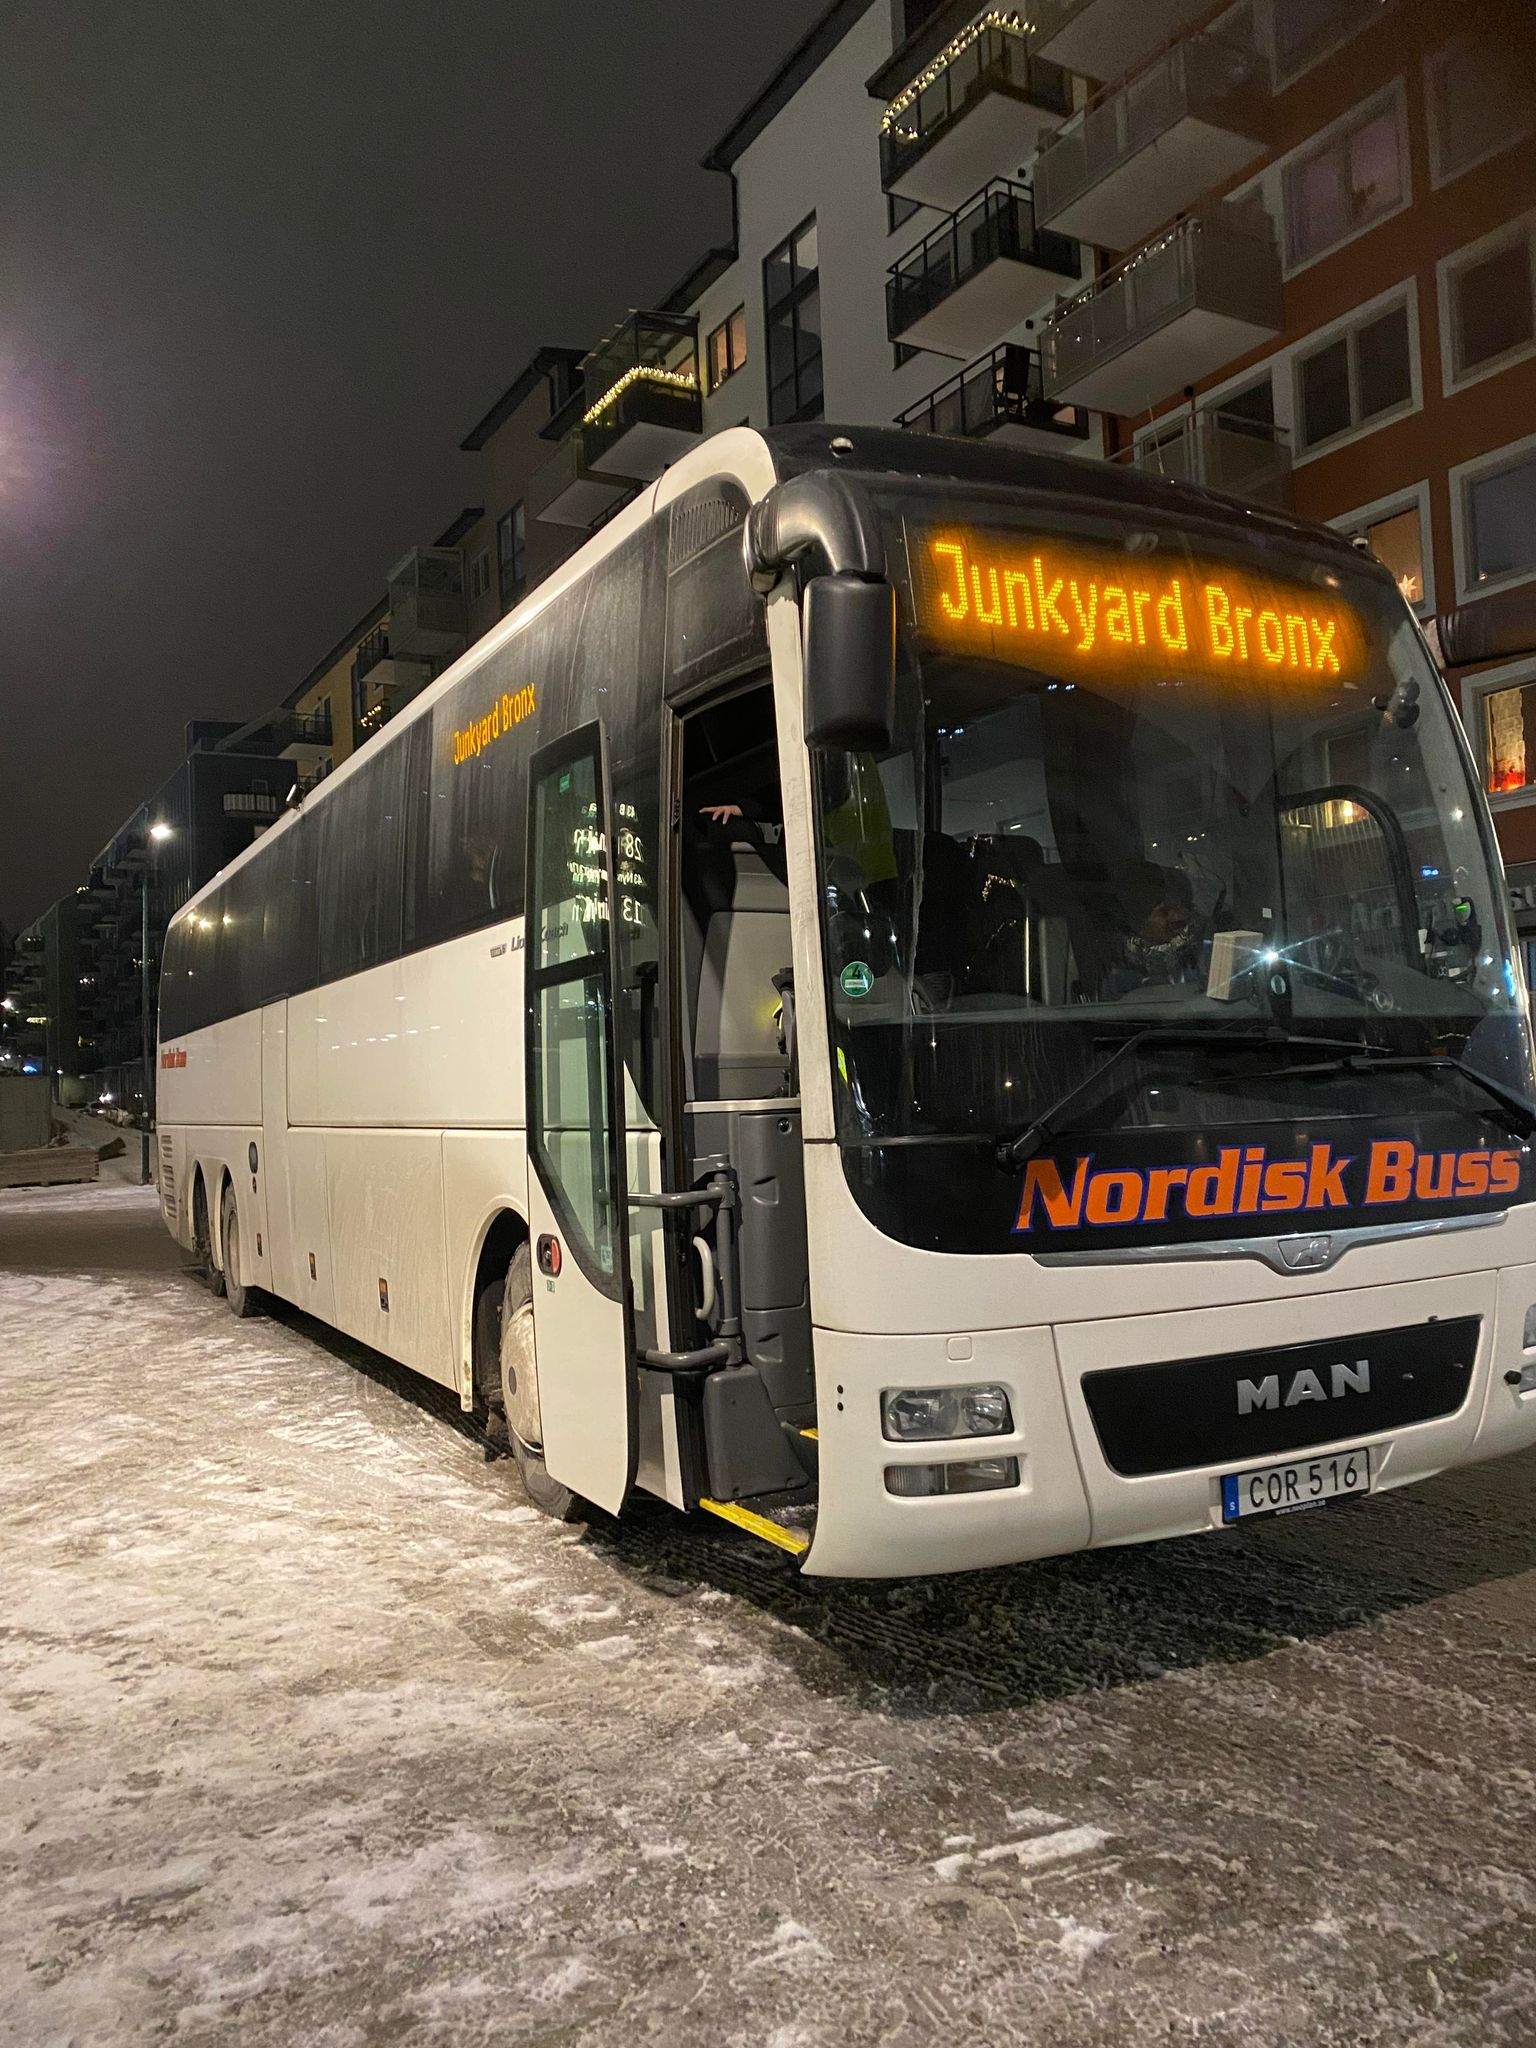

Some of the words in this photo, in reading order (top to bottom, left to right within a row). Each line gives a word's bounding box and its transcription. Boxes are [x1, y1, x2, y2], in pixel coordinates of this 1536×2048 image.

[935, 542, 1188, 651] Junkyard
[1205, 585, 1341, 673] Bronx
[454, 701, 499, 765] Junkyard
[502, 682, 535, 732] Bronx
[1012, 1142, 1355, 1232] Nordisk
[1365, 1139, 1523, 1205] Buss
[1237, 1360, 1371, 1415] MAN
[1229, 1501, 1236, 1511] S
[1250, 1469, 1300, 1508] COR
[1309, 1456, 1358, 1496] 516
